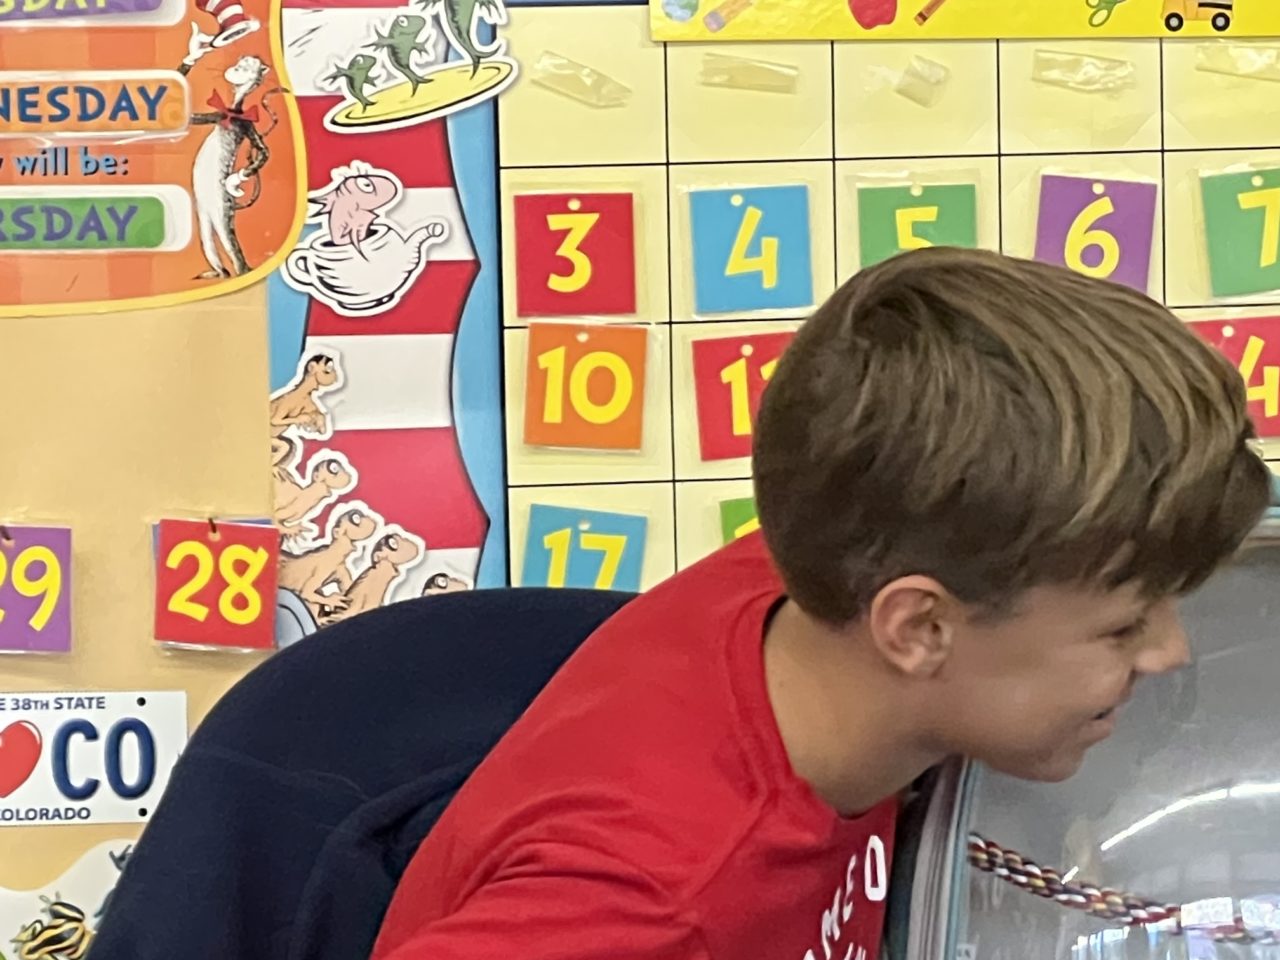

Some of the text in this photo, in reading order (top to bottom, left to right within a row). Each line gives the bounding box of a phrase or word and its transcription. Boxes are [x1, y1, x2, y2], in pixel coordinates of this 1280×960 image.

[14, 147, 68, 176] will
[79, 146, 129, 176] be:
[546, 212, 600, 293] 3
[724, 206, 778, 289] 4
[1064, 196, 1120, 279] 6
[537, 346, 634, 425] 10
[720, 357, 779, 436] 1
[0, 546, 61, 631] 9
[165, 540, 269, 625] 28
[543, 528, 626, 588] 17
[10, 698, 50, 710] 38TH
[54, 696, 106, 710] STATE
[51, 717, 157, 801] CO
[0, 807, 91, 821] OLORADO
